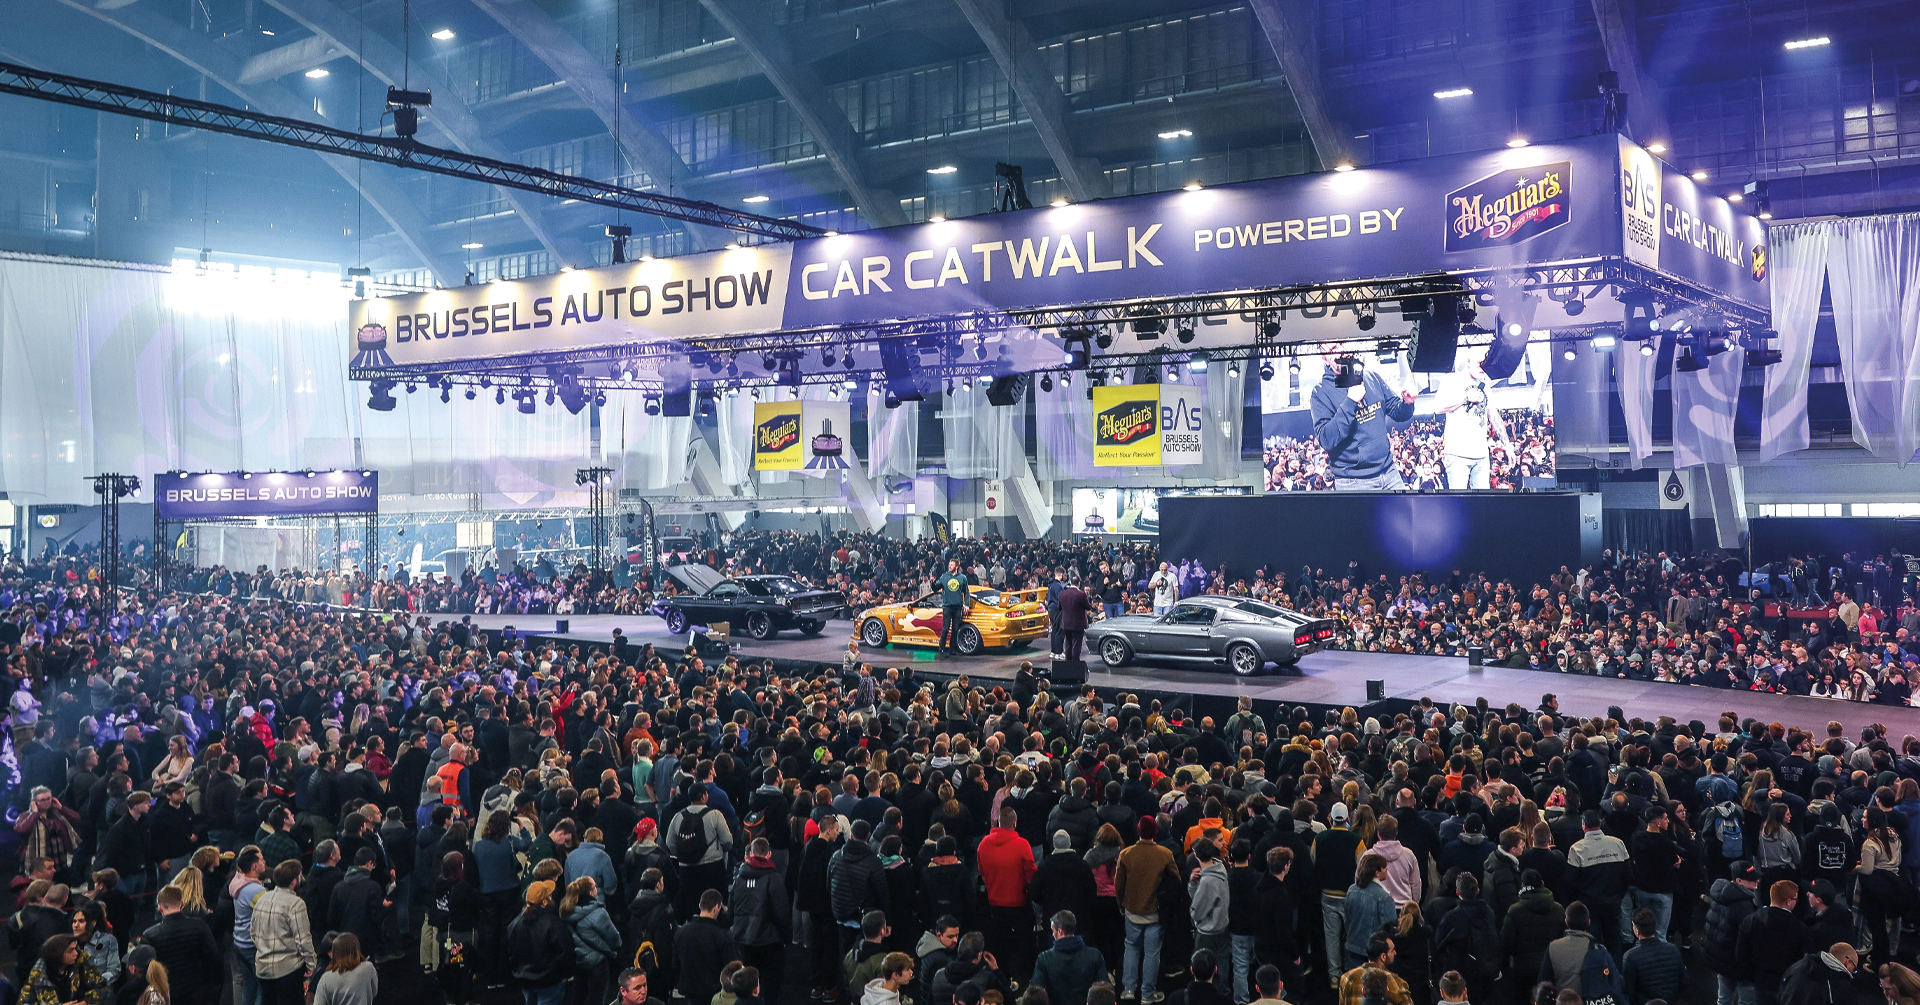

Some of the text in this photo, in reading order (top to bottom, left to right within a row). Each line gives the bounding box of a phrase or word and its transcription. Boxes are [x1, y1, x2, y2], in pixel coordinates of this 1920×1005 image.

[1452, 171, 1561, 239] Meguiar's
[1194, 207, 1405, 252] POWERED BY
[1626, 226, 1656, 251] AUTO SHOW
[1628, 213, 1654, 237] BRUSSELS
[1664, 202, 1691, 244] CAR
[1692, 217, 1745, 268] CATWALK
[801, 223, 1164, 301] CAR CATWALK
[396, 269, 773, 343] BRUSSELS AUTO SHOW
[1100, 405, 1153, 440] Meguiar's
[1161, 397, 1202, 431] BAS
[760, 419, 798, 448] Meguiar's
[1162, 443, 1202, 452] AUTO SHOW
[1165, 434, 1199, 443] BRUSSELS
[166, 485, 373, 503] BRUSSELS AUTO SHOW
[1670, 486, 1678, 496] 4
